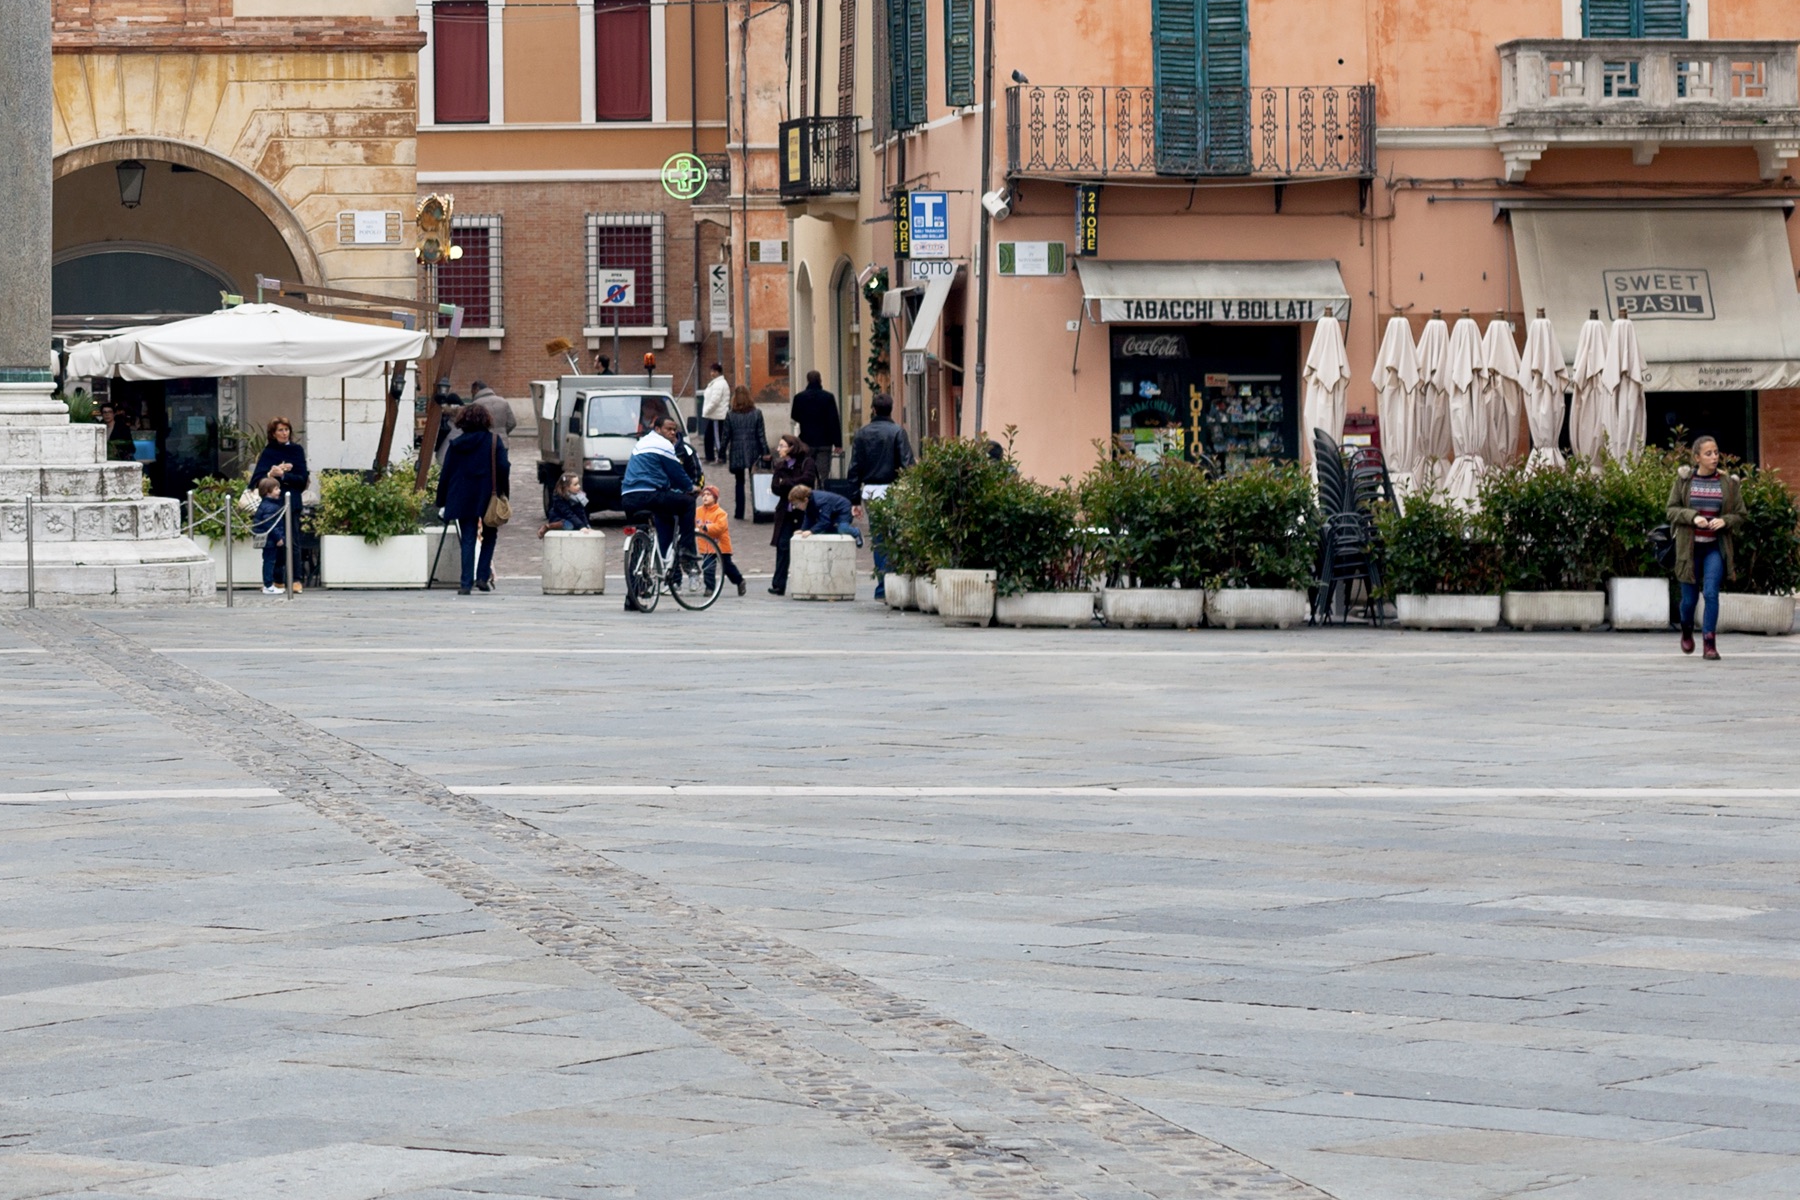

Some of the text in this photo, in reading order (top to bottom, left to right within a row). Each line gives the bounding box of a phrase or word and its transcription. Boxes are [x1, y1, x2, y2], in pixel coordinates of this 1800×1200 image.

[914, 195, 943, 228] T
[1086, 191, 1097, 250] 24 ORE
[899, 196, 909, 252] 24 ORE
[913, 261, 953, 275] LOTTO
[1614, 274, 1699, 291] SWEET
[1123, 300, 1213, 319] TABACCHI
[1238, 300, 1313, 319] BOLLATI
[1622, 296, 1698, 312] BASIL
[1698, 366, 1753, 376] Abbigliamento
[1189, 383, 1203, 456] LOTTO
